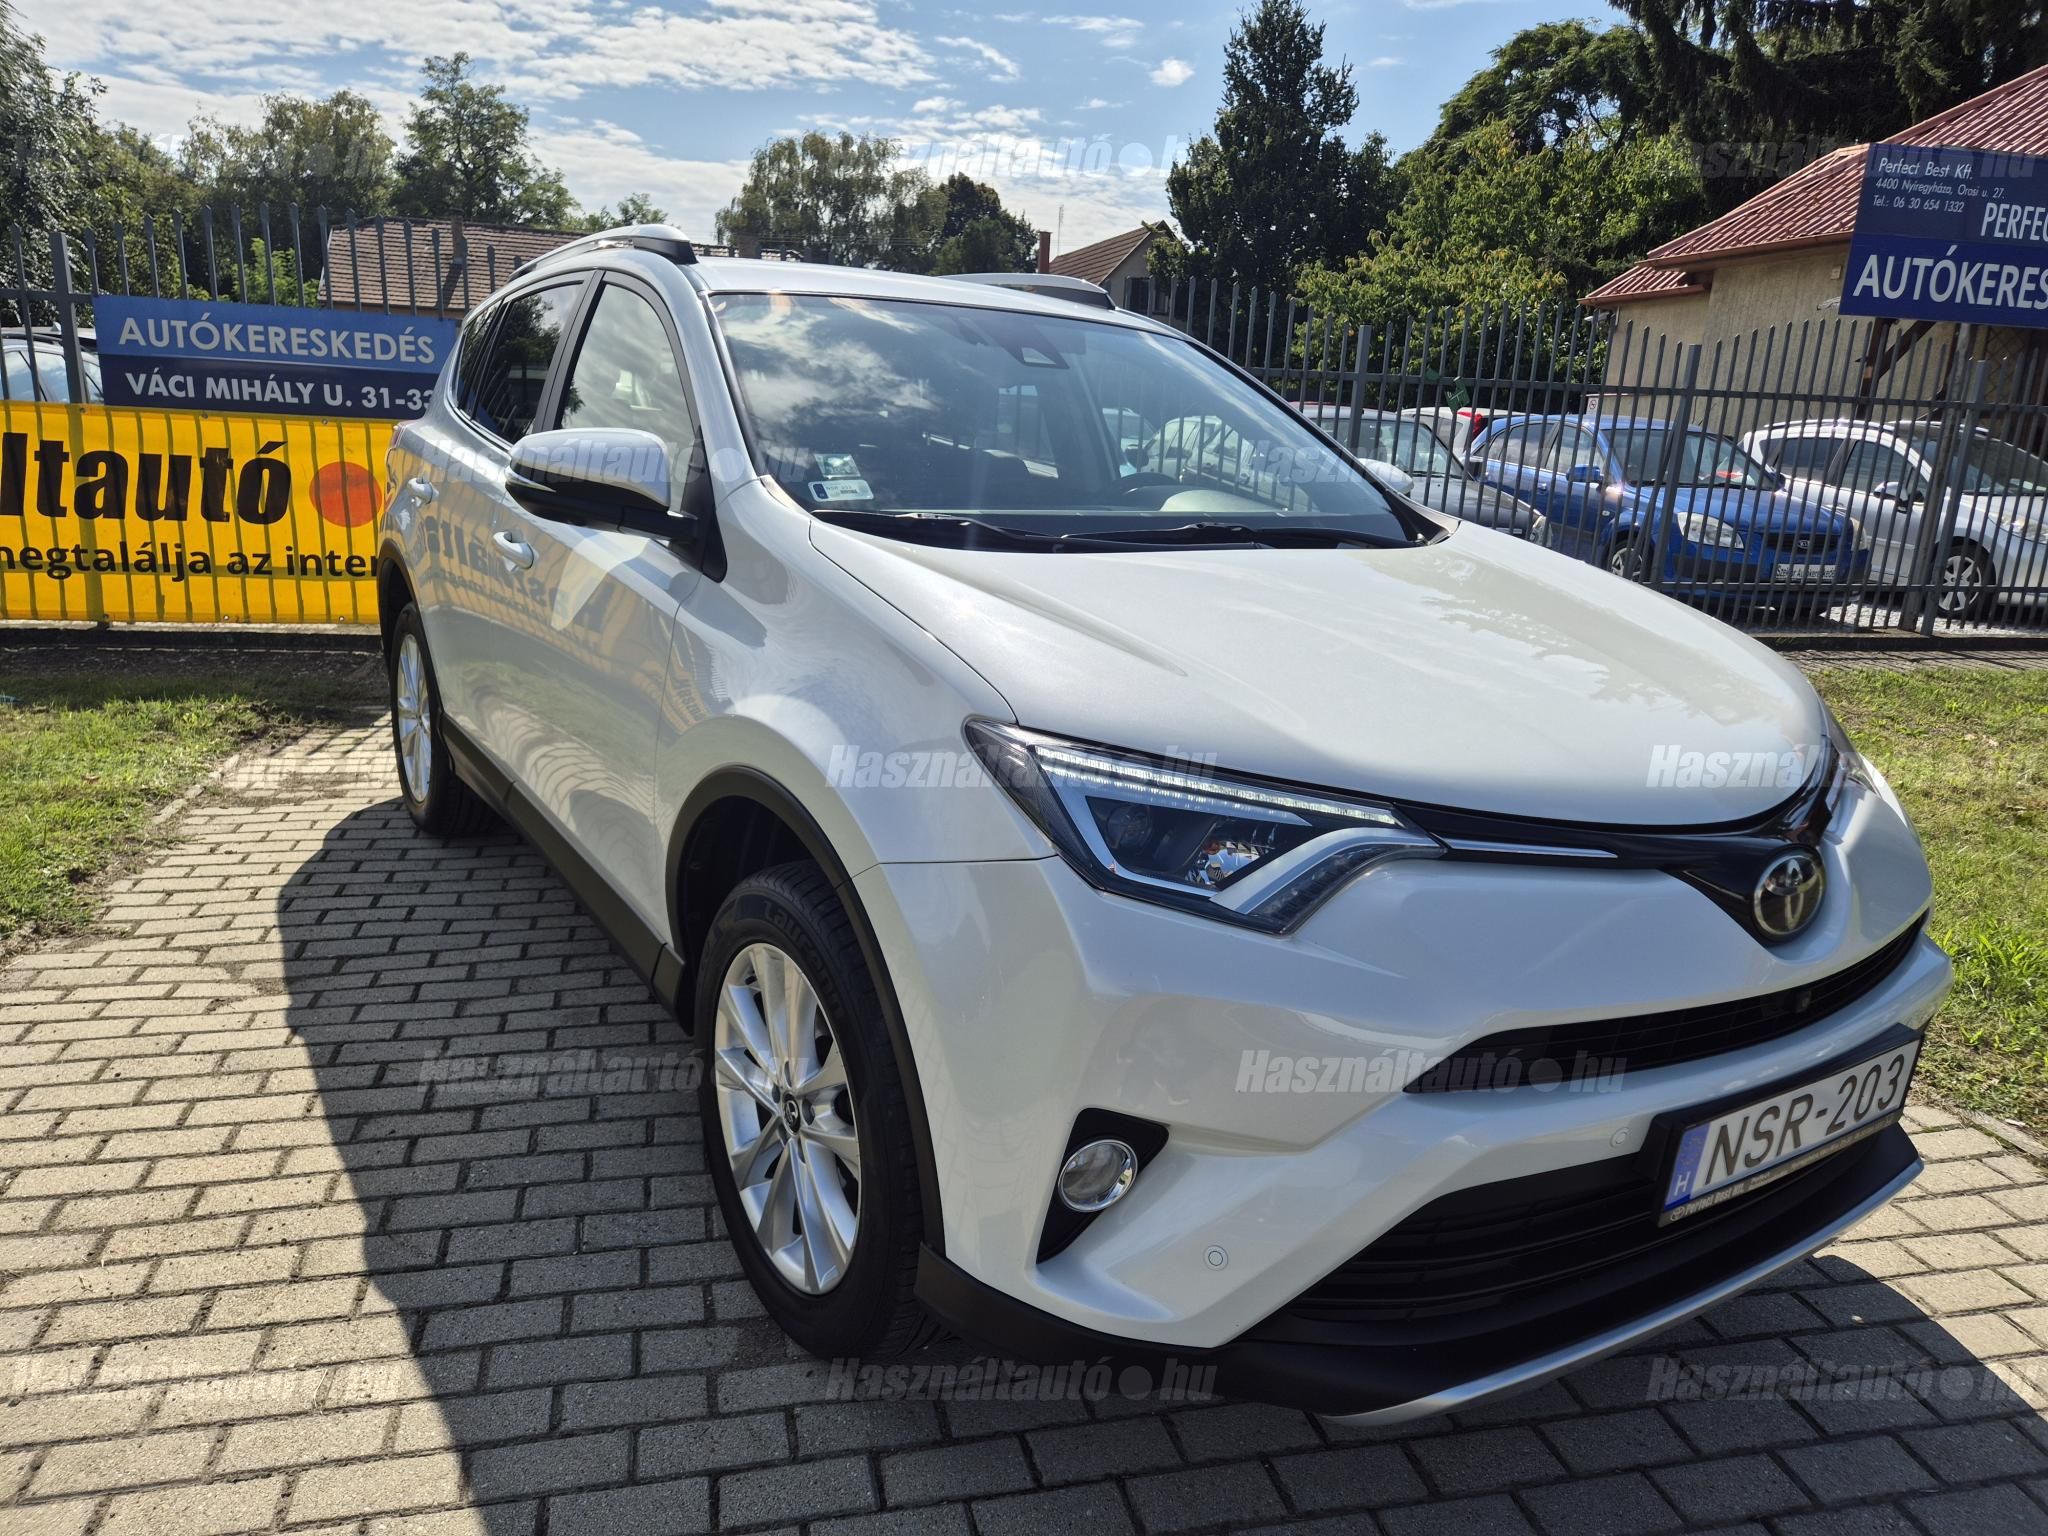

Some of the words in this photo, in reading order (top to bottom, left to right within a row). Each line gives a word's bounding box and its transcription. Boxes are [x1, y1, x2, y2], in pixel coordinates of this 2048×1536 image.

[1878, 157, 1920, 175] Perfect
[1925, 161, 1950, 178] Best
[1954, 163, 1974, 180] Kft.
[1875, 177, 1899, 190] 4400
[1893, 196, 1906, 208] 06
[1908, 197, 1921, 209] 30
[1923, 199, 1940, 211] 654
[1944, 200, 1965, 213] 1332
[1852, 244, 2048, 311] AUTÓKERES
[119, 311, 436, 365] AUTÓKERESKEDÉS
[125, 367, 195, 398] VÁCI
[205, 374, 315, 406] MIHÁLY
[323, 384, 353, 407] U.
[227, 551, 273, 576] az
[1704, 1053, 1905, 1186] NSR-203
[1674, 1171, 1691, 1196] H
